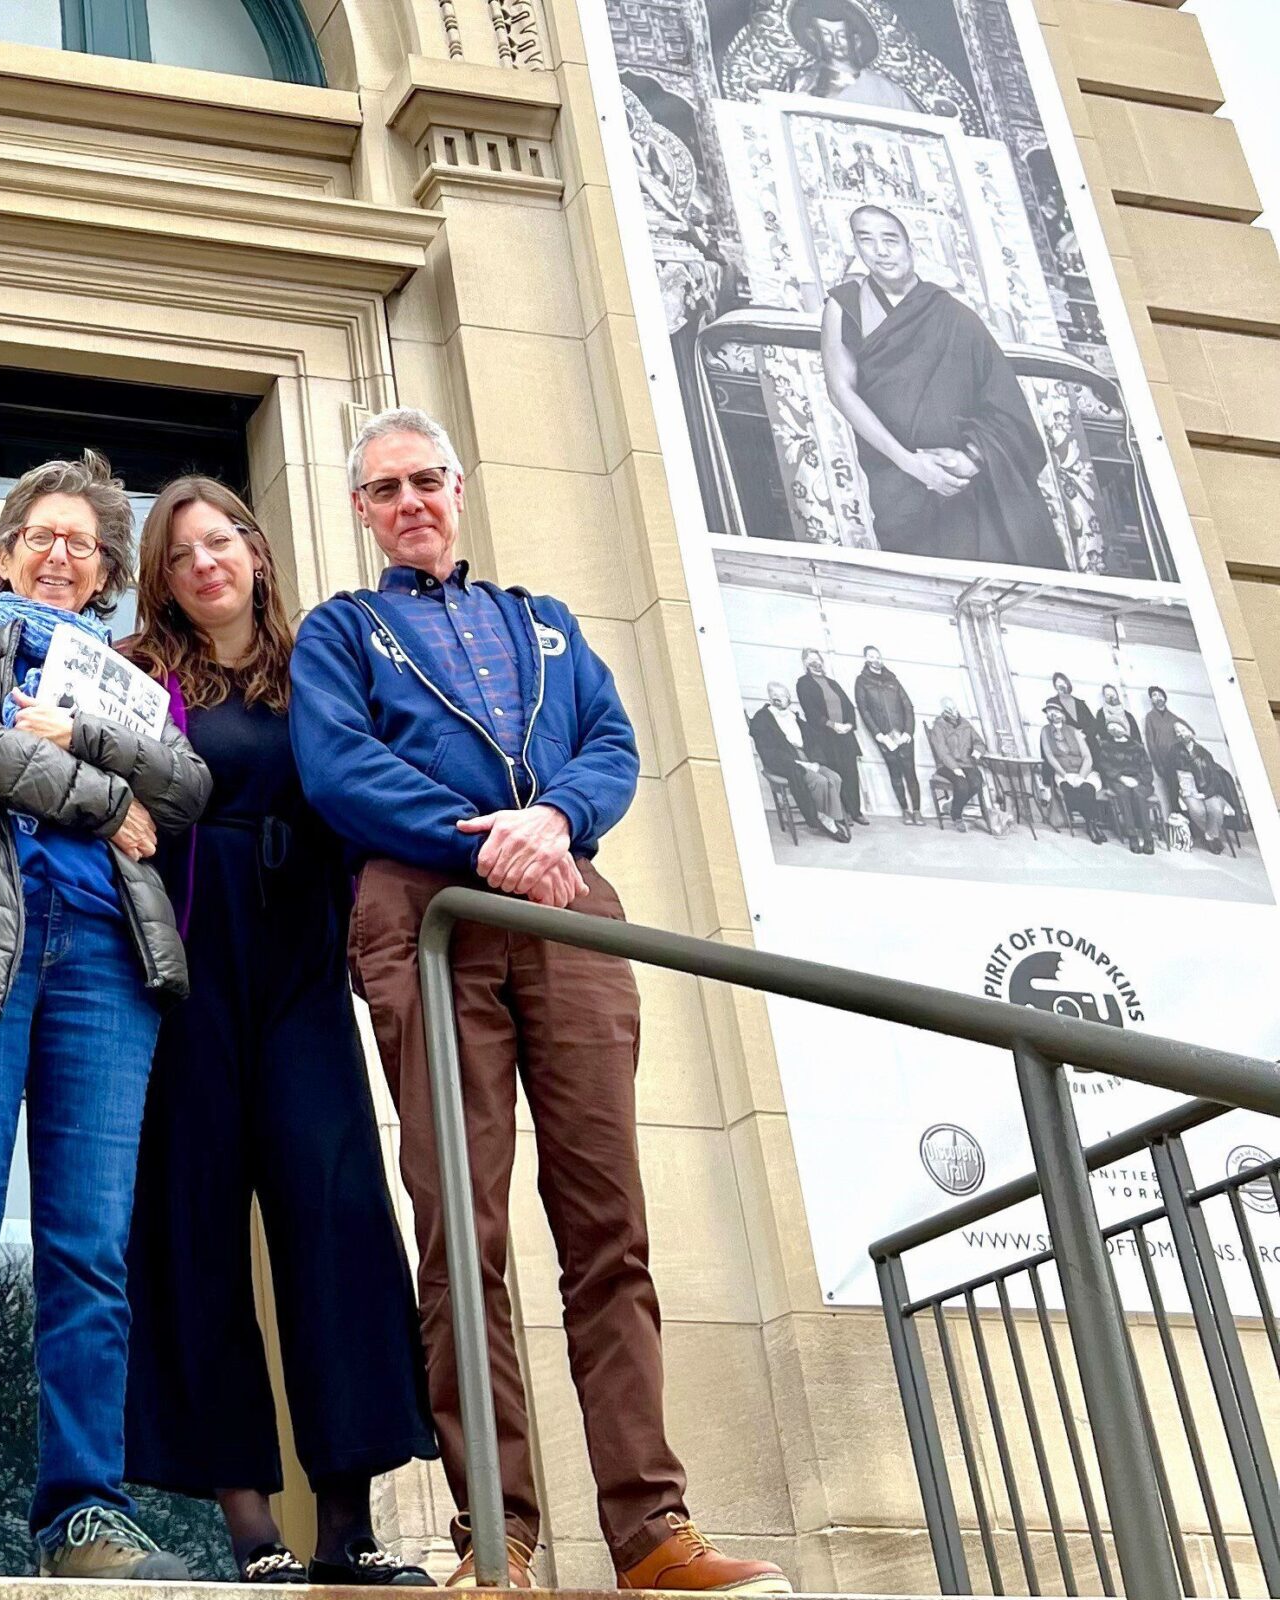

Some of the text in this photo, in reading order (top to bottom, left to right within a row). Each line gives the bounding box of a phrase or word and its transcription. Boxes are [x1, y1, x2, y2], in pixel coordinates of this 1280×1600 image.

[984, 926, 1145, 1022] PIRIT OF TOMPKINS
[1108, 1186, 1163, 1199] YORK
